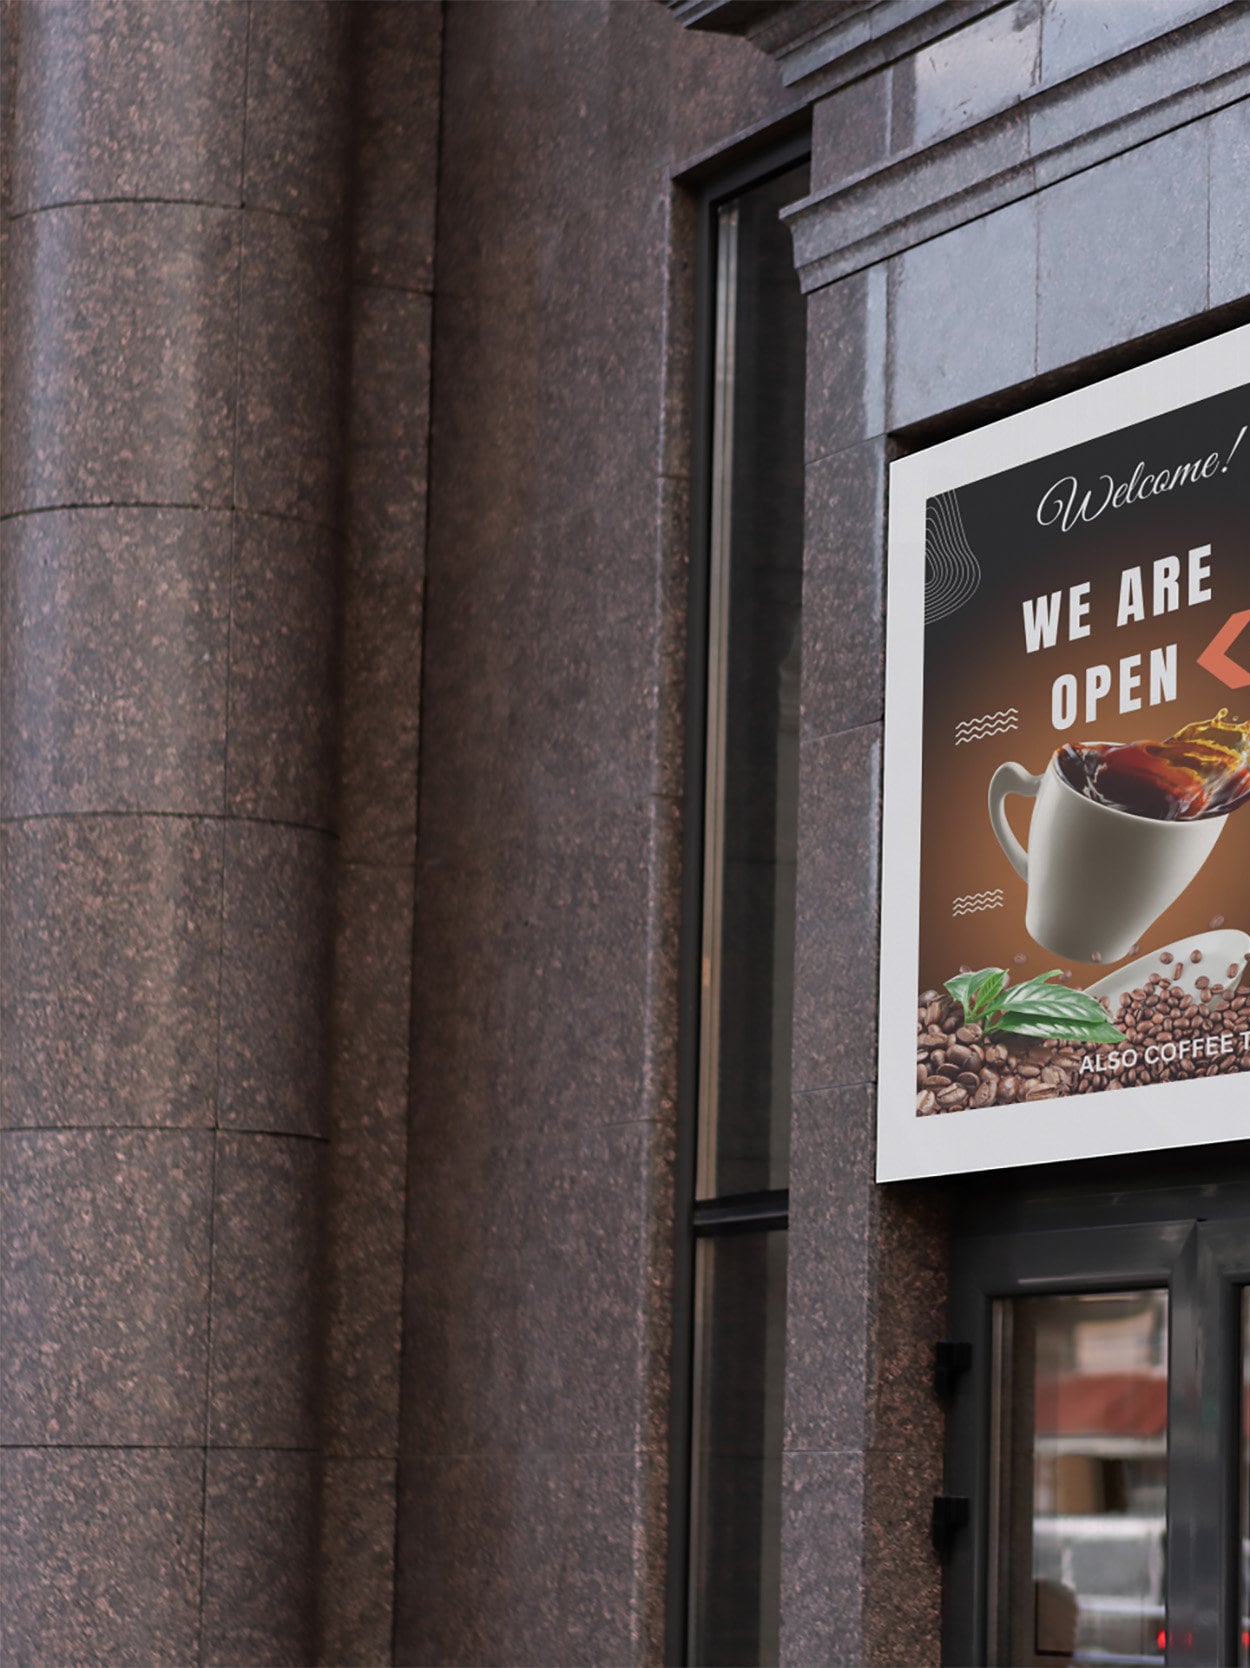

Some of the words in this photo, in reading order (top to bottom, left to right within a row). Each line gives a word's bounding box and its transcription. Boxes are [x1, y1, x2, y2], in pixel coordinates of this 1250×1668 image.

[1036, 425, 1248, 532] Welcome!
[1022, 581, 1091, 653] WE
[1117, 543, 1212, 627] ARE
[1051, 643, 1178, 731] OPEN
[1079, 1049, 1138, 1074] ALSO
[1144, 1034, 1234, 1064] COFFEE
